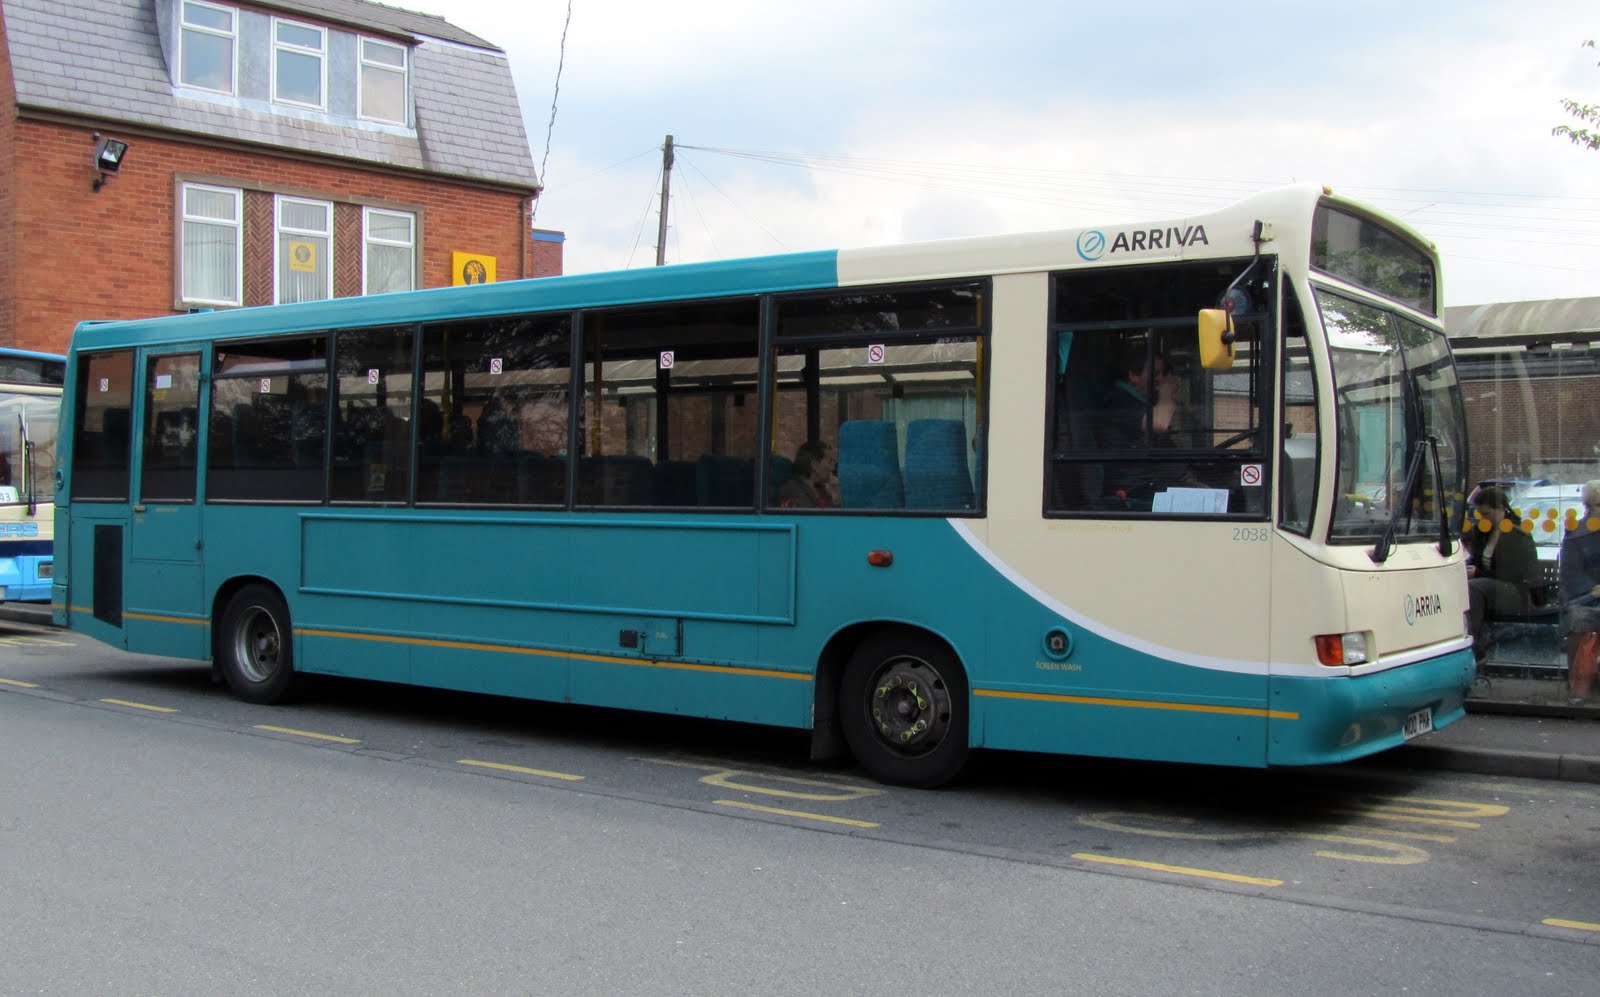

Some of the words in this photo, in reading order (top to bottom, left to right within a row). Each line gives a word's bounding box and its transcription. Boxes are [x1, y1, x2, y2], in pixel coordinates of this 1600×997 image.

[1110, 224, 1209, 253] ARRIVA
[1232, 527, 1269, 542] 2038
[1415, 593, 1442, 618] ARRIVA
[1061, 662, 1082, 672] WASH
